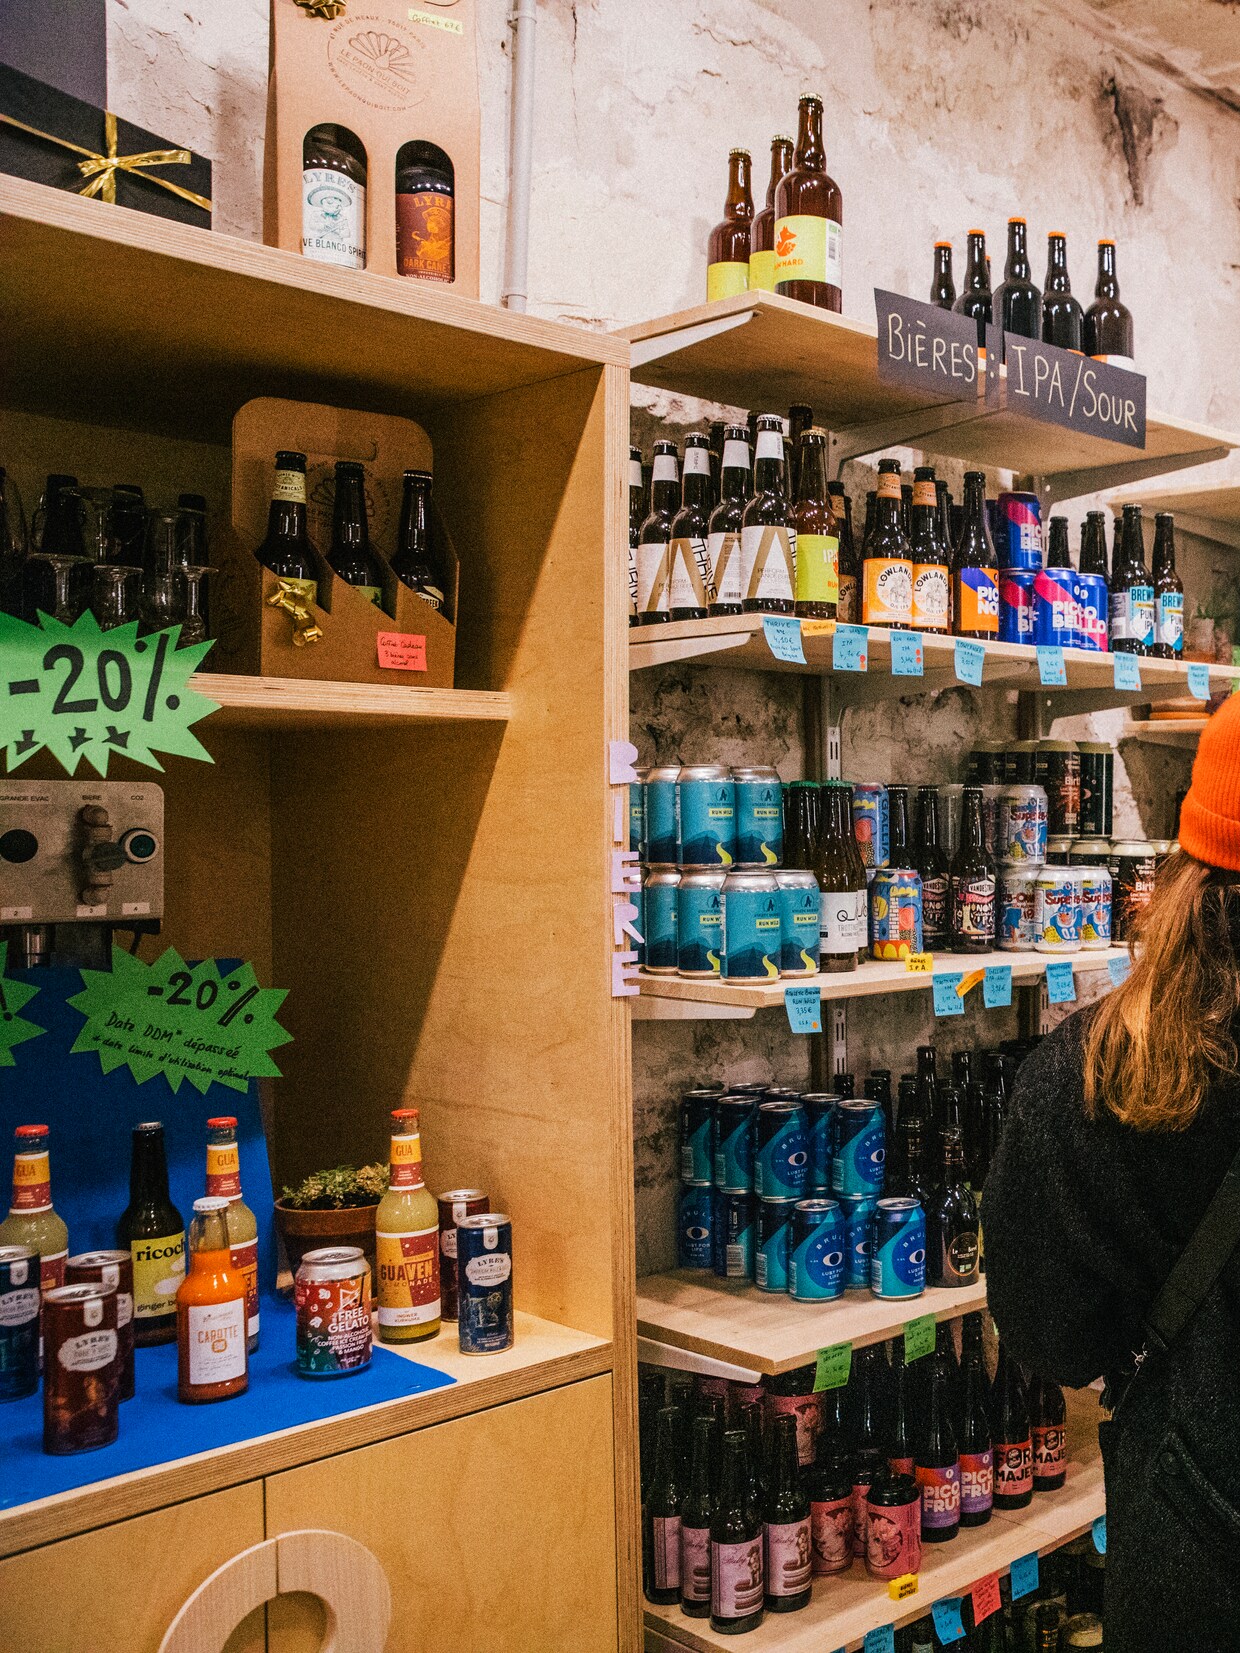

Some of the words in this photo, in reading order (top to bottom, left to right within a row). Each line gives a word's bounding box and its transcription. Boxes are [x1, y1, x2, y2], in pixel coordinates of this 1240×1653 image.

[315, 239, 347, 253] BLANCO
[8, 632, 181, 723] -20%
[881, 798, 890, 867] GALLIA
[147, 971, 261, 1028] -20%
[105, 1011, 135, 1033] Date
[217, 1153, 236, 1167] GUA
[395, 1144, 413, 1157] GUA
[327, 1314, 369, 1334] GELATO
[338, 1306, 364, 1322] FREE
[197, 1324, 239, 1344] CAROTTE
